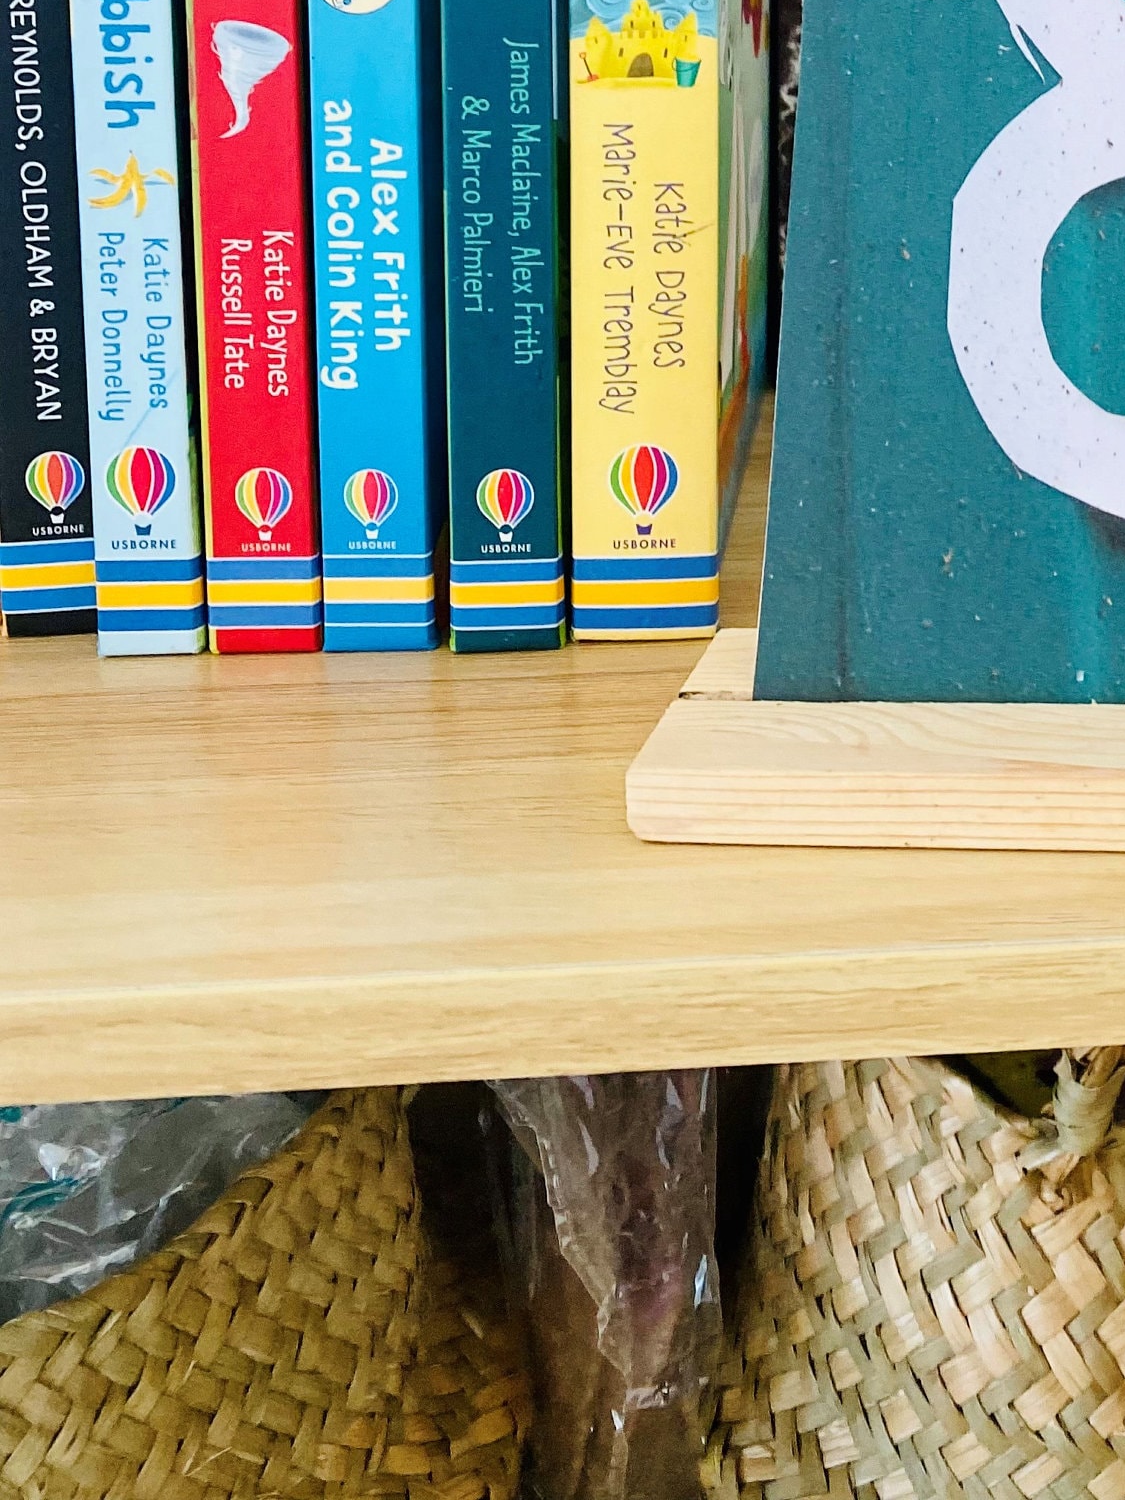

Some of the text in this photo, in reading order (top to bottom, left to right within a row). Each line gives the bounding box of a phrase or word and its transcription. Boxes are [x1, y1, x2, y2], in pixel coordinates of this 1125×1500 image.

[21, 162, 53, 287] OLDHAM
[320, 99, 365, 390] and Colin King
[371, 139, 410, 350] Alex Frith
[461, 95, 493, 312] & Marco Palmieri
[503, 37, 544, 364] James Maclaine, Alex Frith
[599, 124, 637, 414] Marie-Eve Tremblay
[648, 183, 694, 367] Katie Daynes
[30, 299, 55, 317] &
[32, 328, 62, 420] BRYAN
[98, 233, 131, 421] Peter Donnelly
[140, 239, 172, 408] Katie Daynes
[221, 239, 254, 388] Russell Tate
[262, 231, 297, 396] Katie Daynes
[32, 523, 85, 537] USBORNE
[111, 539, 176, 550] USBORNE
[241, 542, 291, 553] USBORNE
[348, 540, 397, 550] USBORNE
[480, 543, 532, 554] USBORNE
[612, 538, 676, 550] USBORNE
